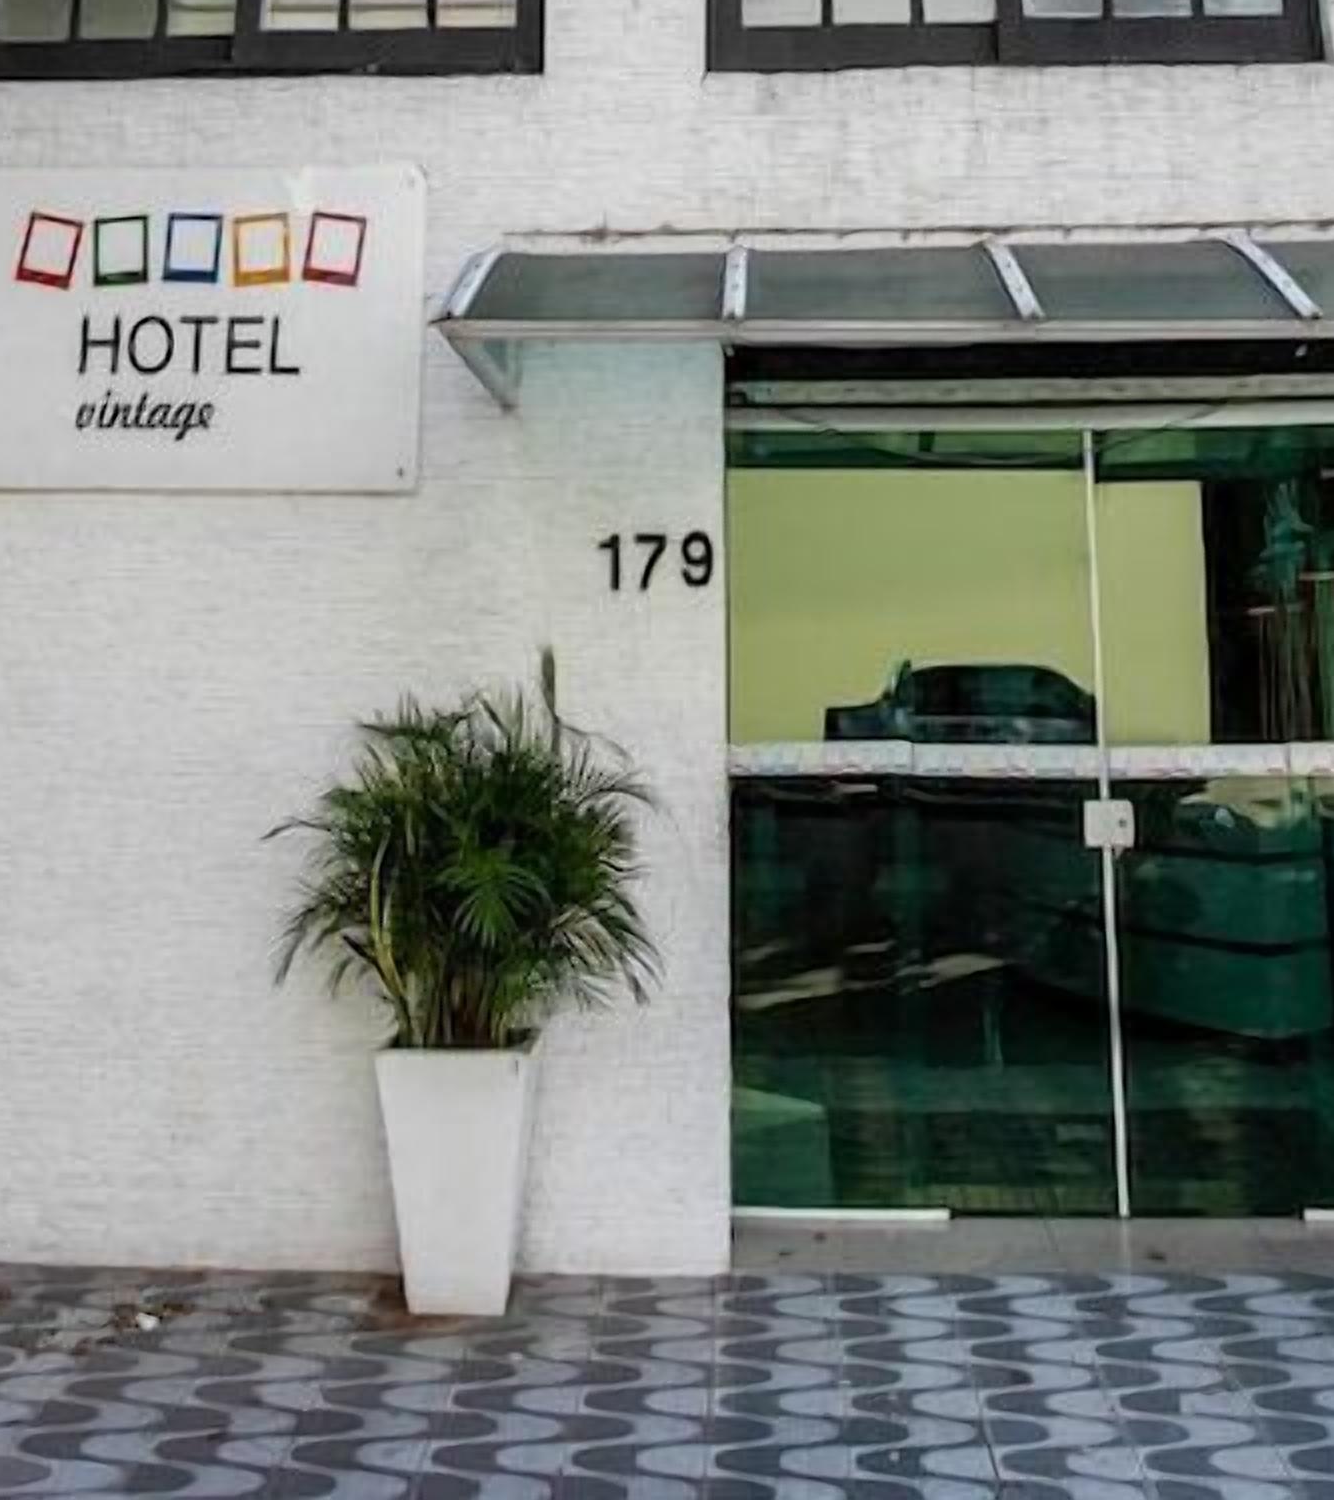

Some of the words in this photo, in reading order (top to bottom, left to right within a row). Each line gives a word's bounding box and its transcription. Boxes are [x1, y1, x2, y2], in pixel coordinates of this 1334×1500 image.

[78, 314, 300, 376] HOTEL
[75, 388, 214, 442] vintage
[598, 530, 714, 591] 179
